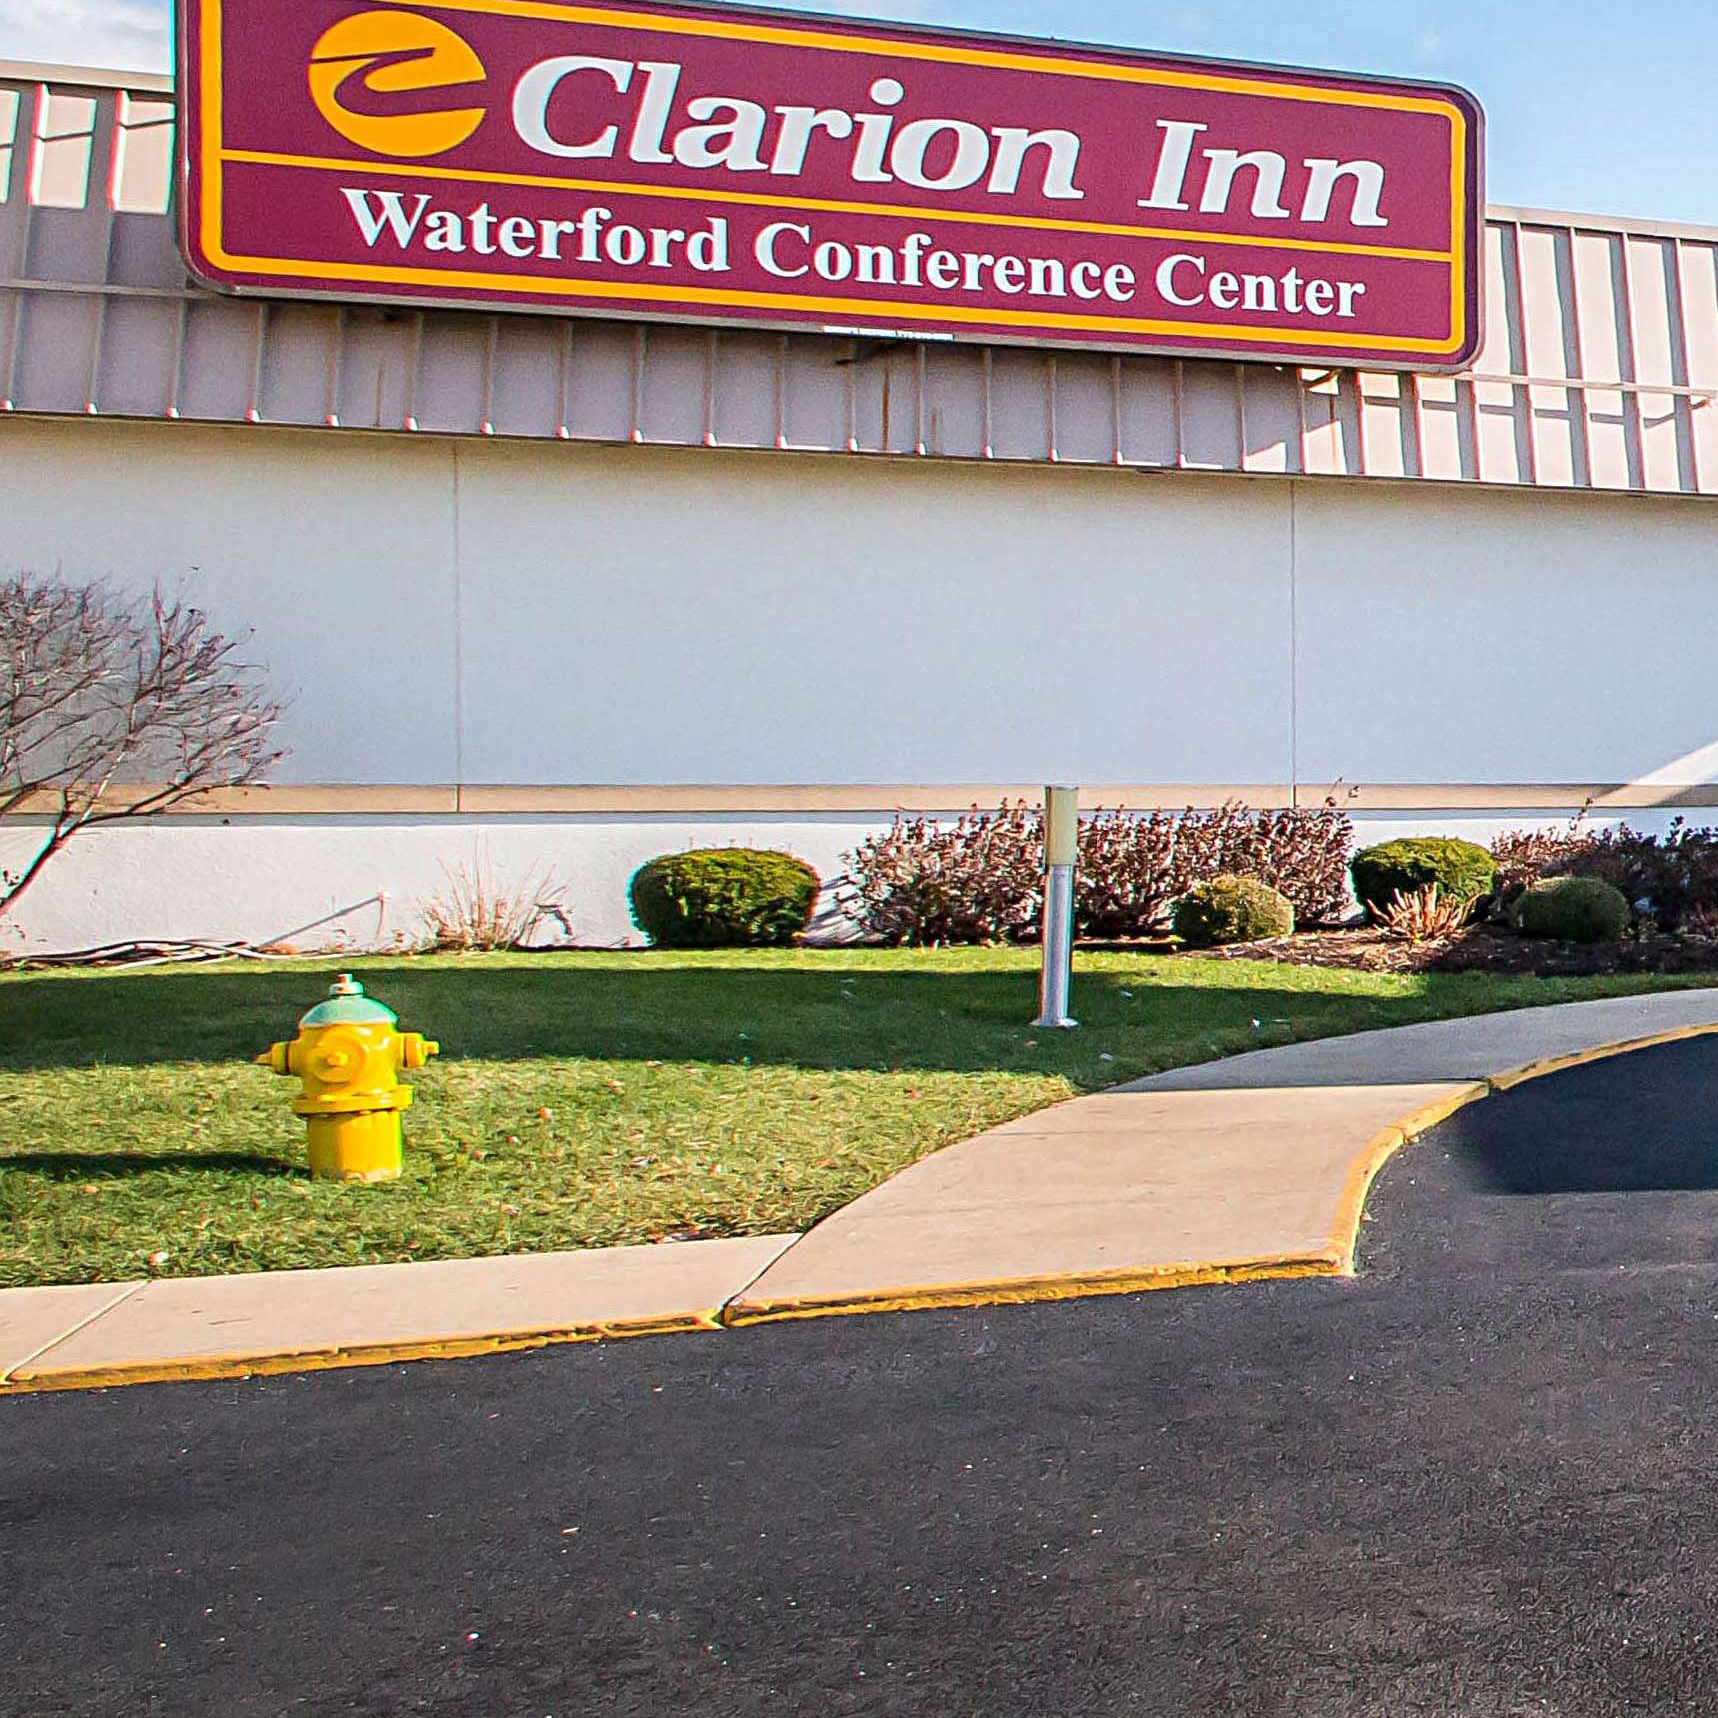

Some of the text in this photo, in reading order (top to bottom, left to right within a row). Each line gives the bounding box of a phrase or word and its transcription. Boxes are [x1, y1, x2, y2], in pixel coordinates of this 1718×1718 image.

[512, 55, 1389, 227] Clarion Inn
[339, 188, 1366, 317] Waterford Conference Center
